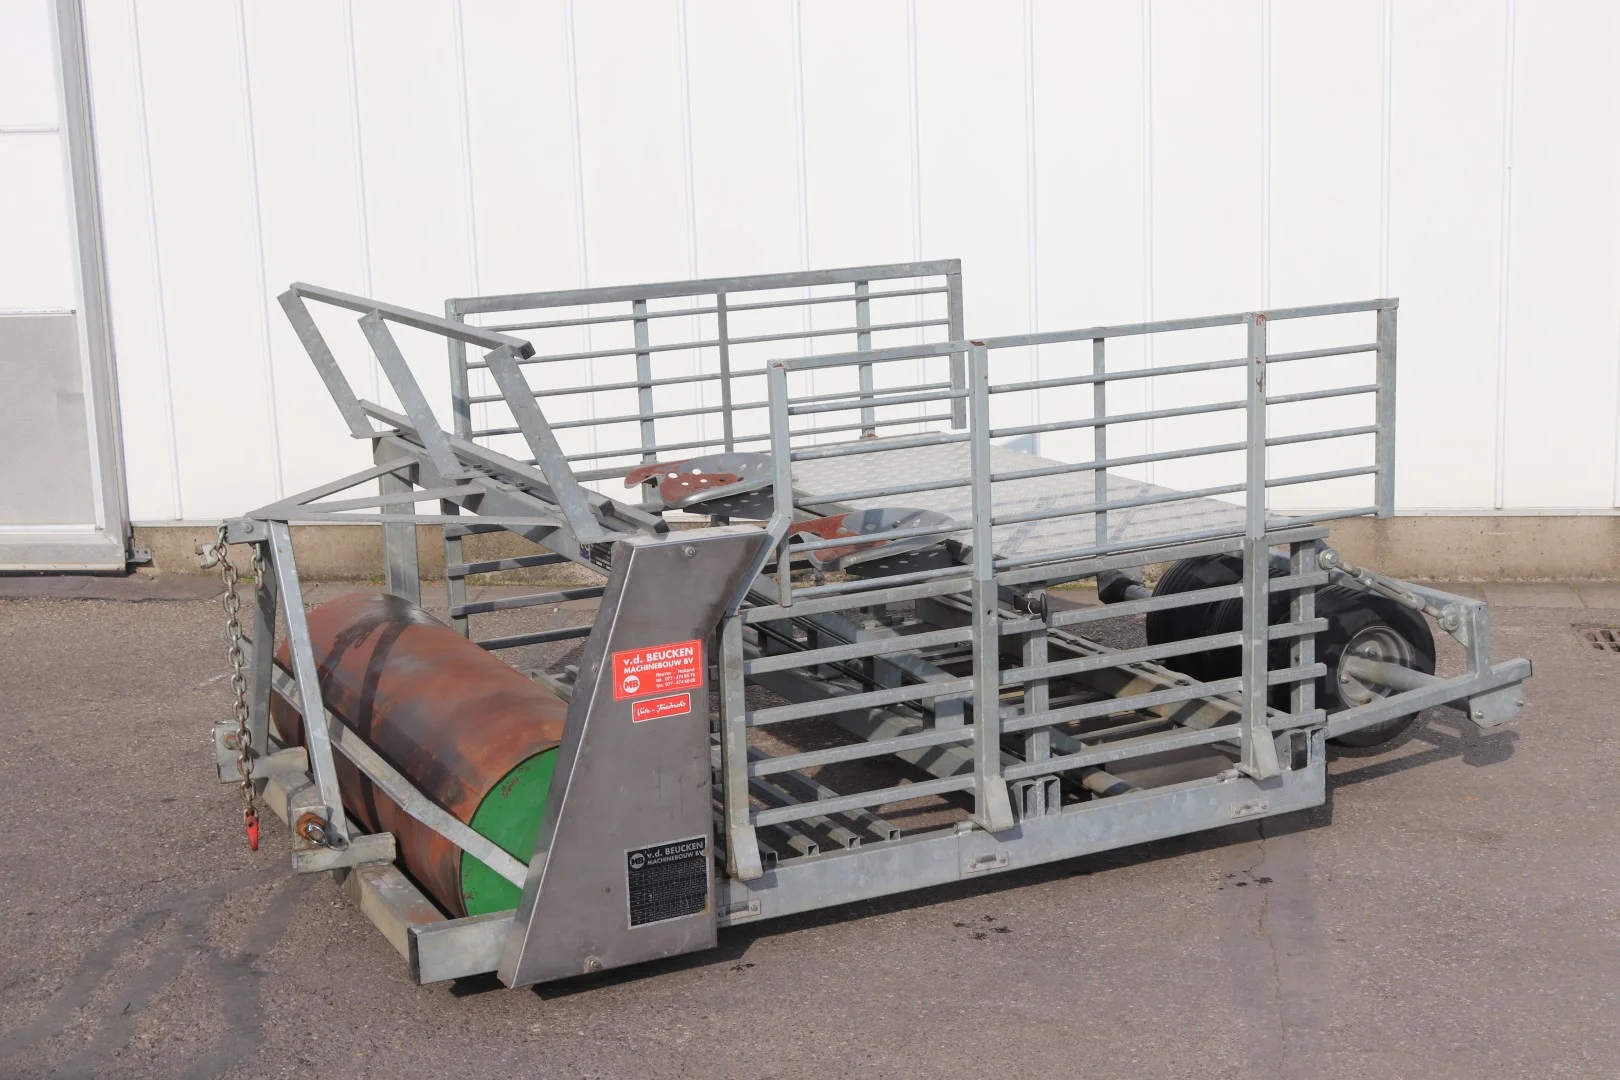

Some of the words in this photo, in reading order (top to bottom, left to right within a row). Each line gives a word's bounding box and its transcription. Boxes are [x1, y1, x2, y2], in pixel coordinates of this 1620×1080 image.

[646, 647, 693, 662] BEUCKEN
[623, 659, 682, 674] MACHINEBOUW
[683, 657, 693, 665] BV
[624, 679, 639, 689] MB
[630, 856, 643, 866] MB
[665, 841, 704, 855] BEUCKEN
[647, 851, 694, 866] MACHINEBOUW
